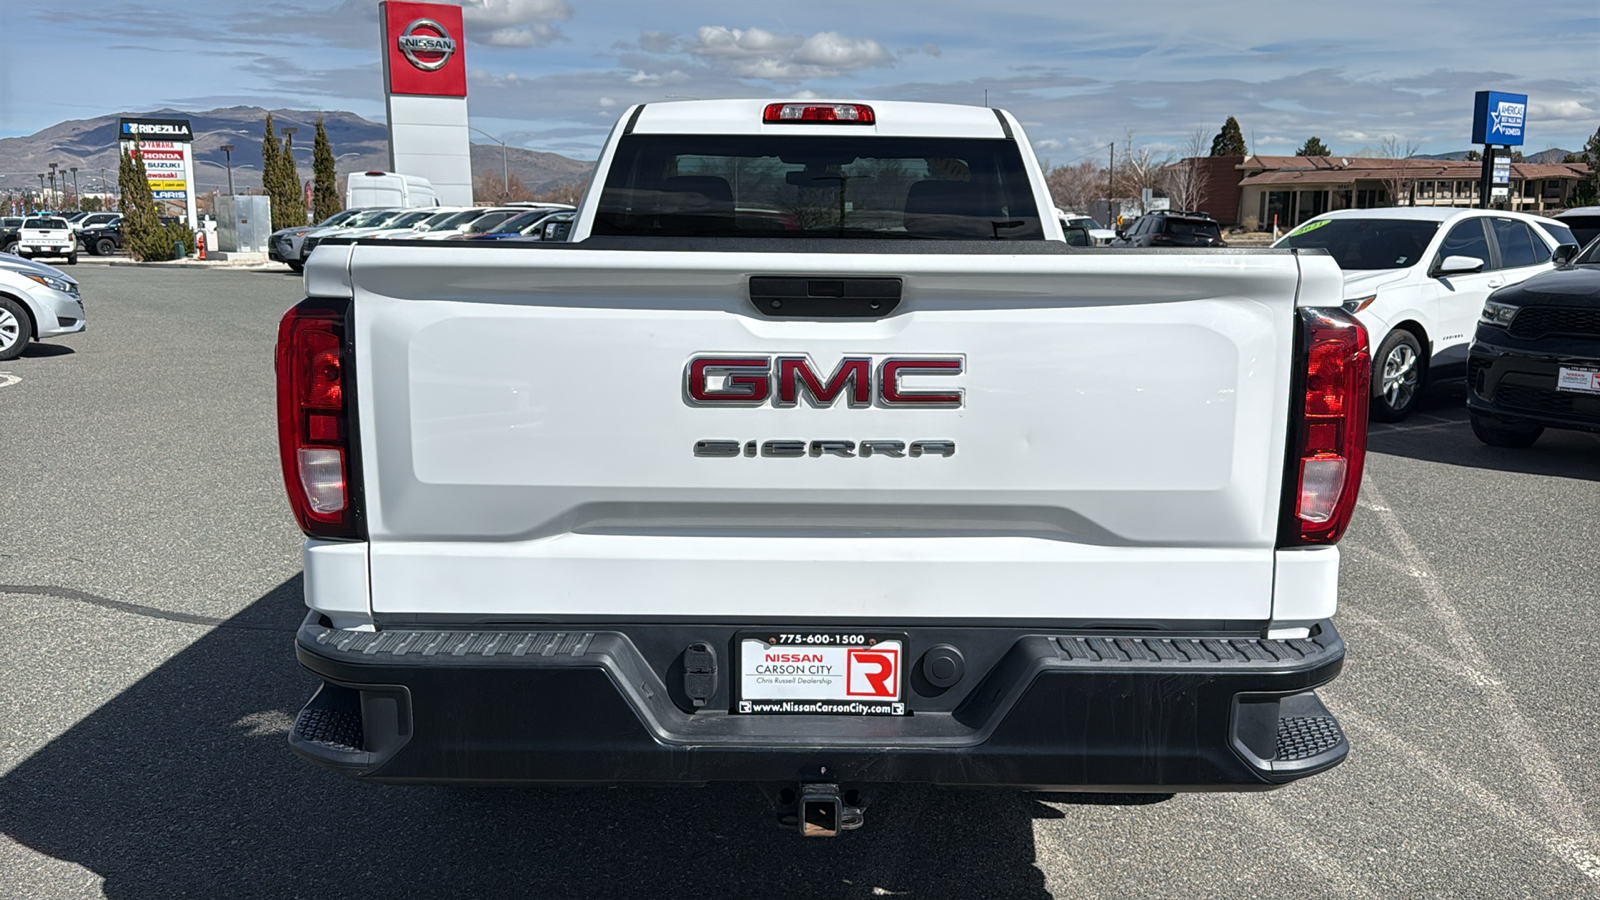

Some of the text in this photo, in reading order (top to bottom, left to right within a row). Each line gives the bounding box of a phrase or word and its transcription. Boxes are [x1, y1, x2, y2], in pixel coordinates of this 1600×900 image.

[405, 38, 452, 49] NISSAN
[139, 124, 188, 134] RIDEZILLA
[684, 353, 965, 408] GMC
[693, 440, 956, 458] SIERRA
[780, 635, 865, 644] 775-600-1500
[765, 654, 823, 663] NISSAN
[756, 665, 833, 675] CARSON CITY
[797, 677, 833, 686] Dealership
[753, 702, 891, 715] www.NissanCarsonCity.com
